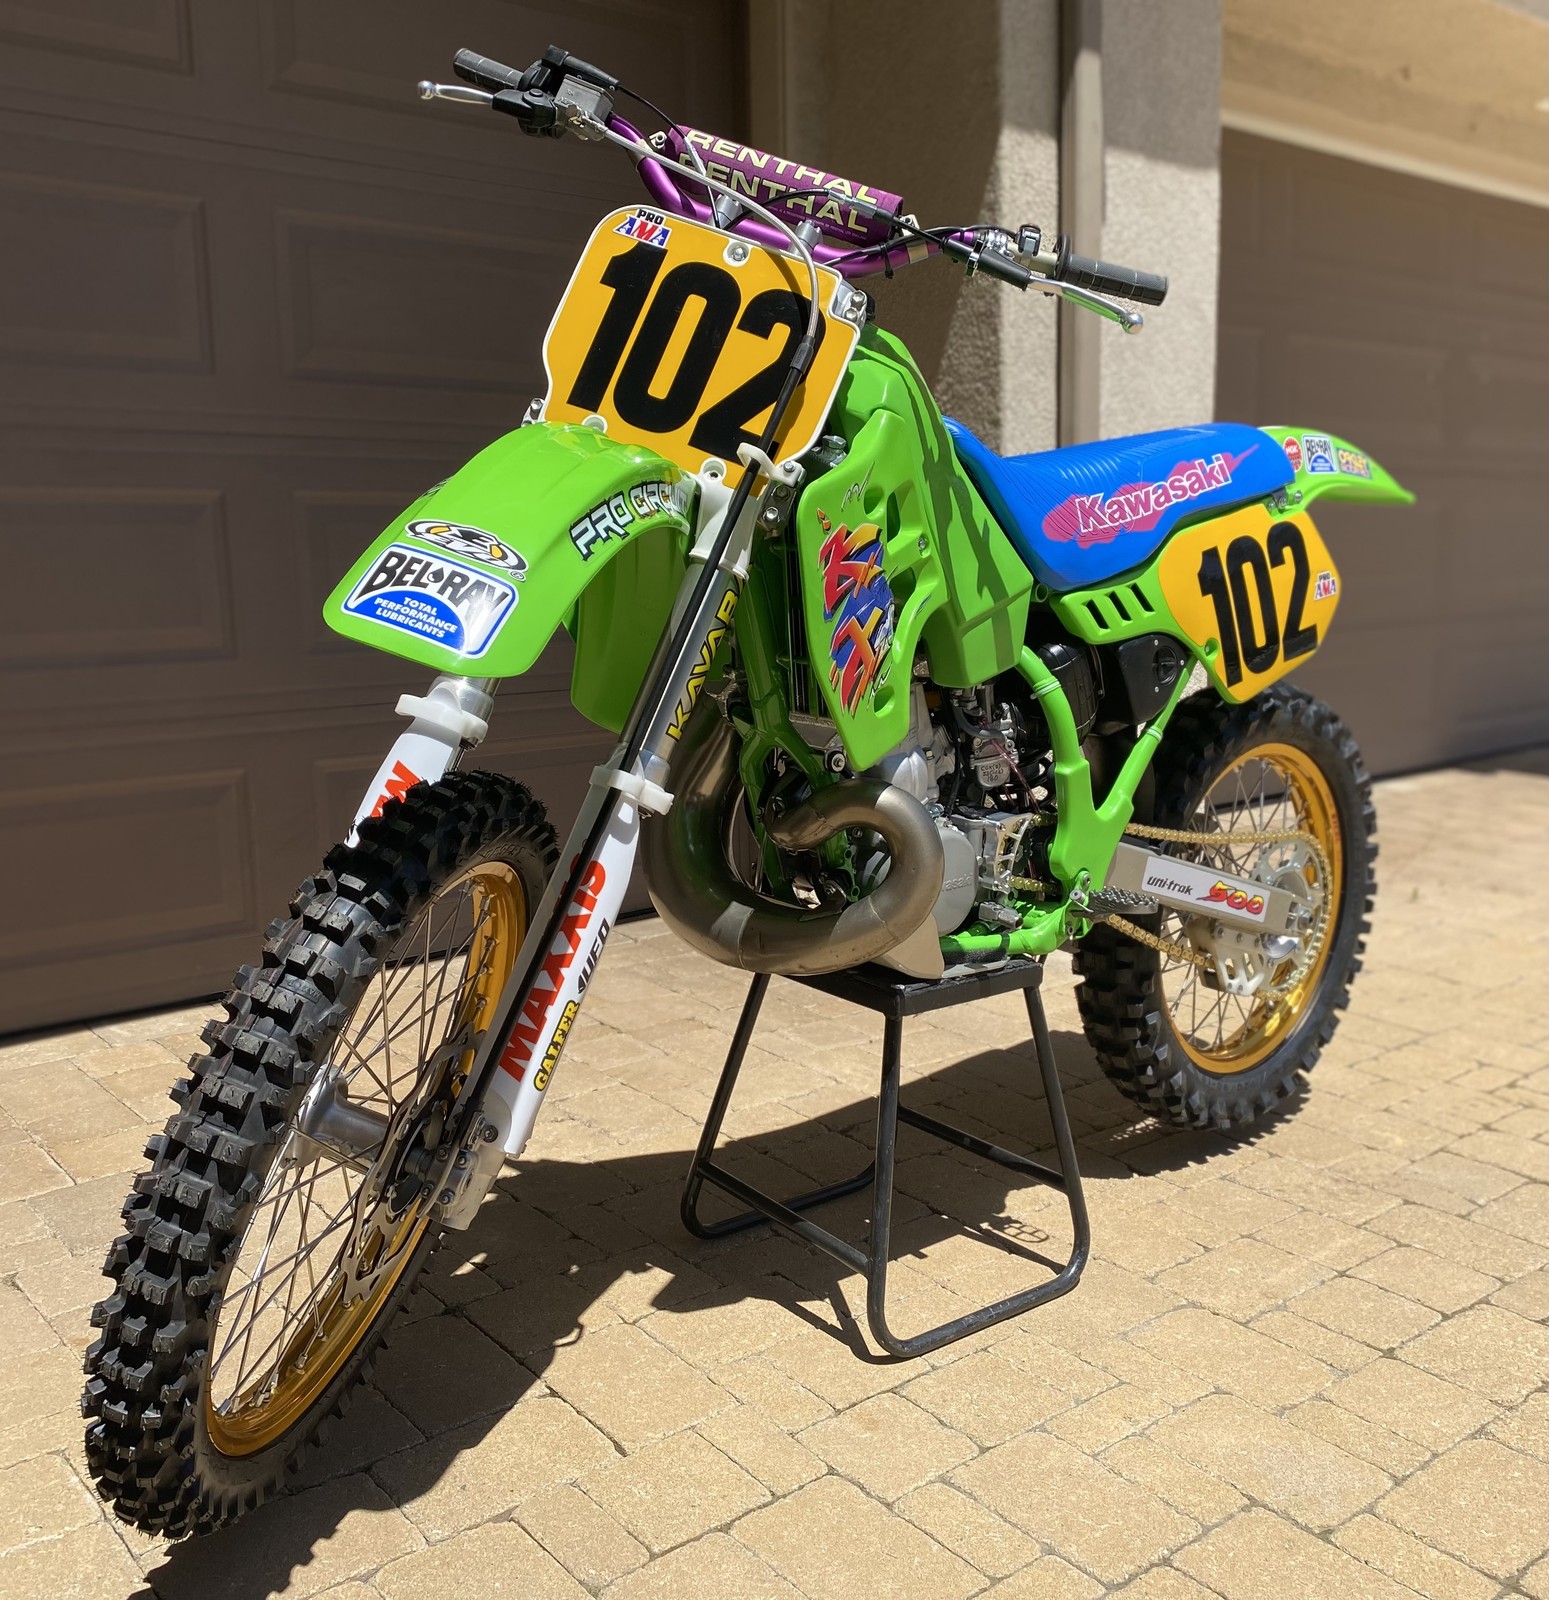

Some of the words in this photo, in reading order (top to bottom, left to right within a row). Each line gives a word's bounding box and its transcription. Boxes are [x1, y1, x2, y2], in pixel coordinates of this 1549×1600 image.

[685, 129, 878, 204] RENTHAL
[615, 216, 671, 247] AMA
[637, 208, 665, 225] PRO
[566, 240, 827, 468] 102
[569, 490, 636, 561] PRO
[1075, 453, 1233, 533] Kawasaki
[374, 597, 458, 634] PERFORMANCE
[375, 608, 446, 639] LUBRICANTS
[403, 597, 438, 616] TOTAL
[1197, 520, 1319, 689] 102
[1146, 875, 1194, 896] uni-trak
[1198, 880, 1265, 915] 500
[498, 852, 607, 1083] MAXXIS
[533, 1000, 581, 1092] GALFER
